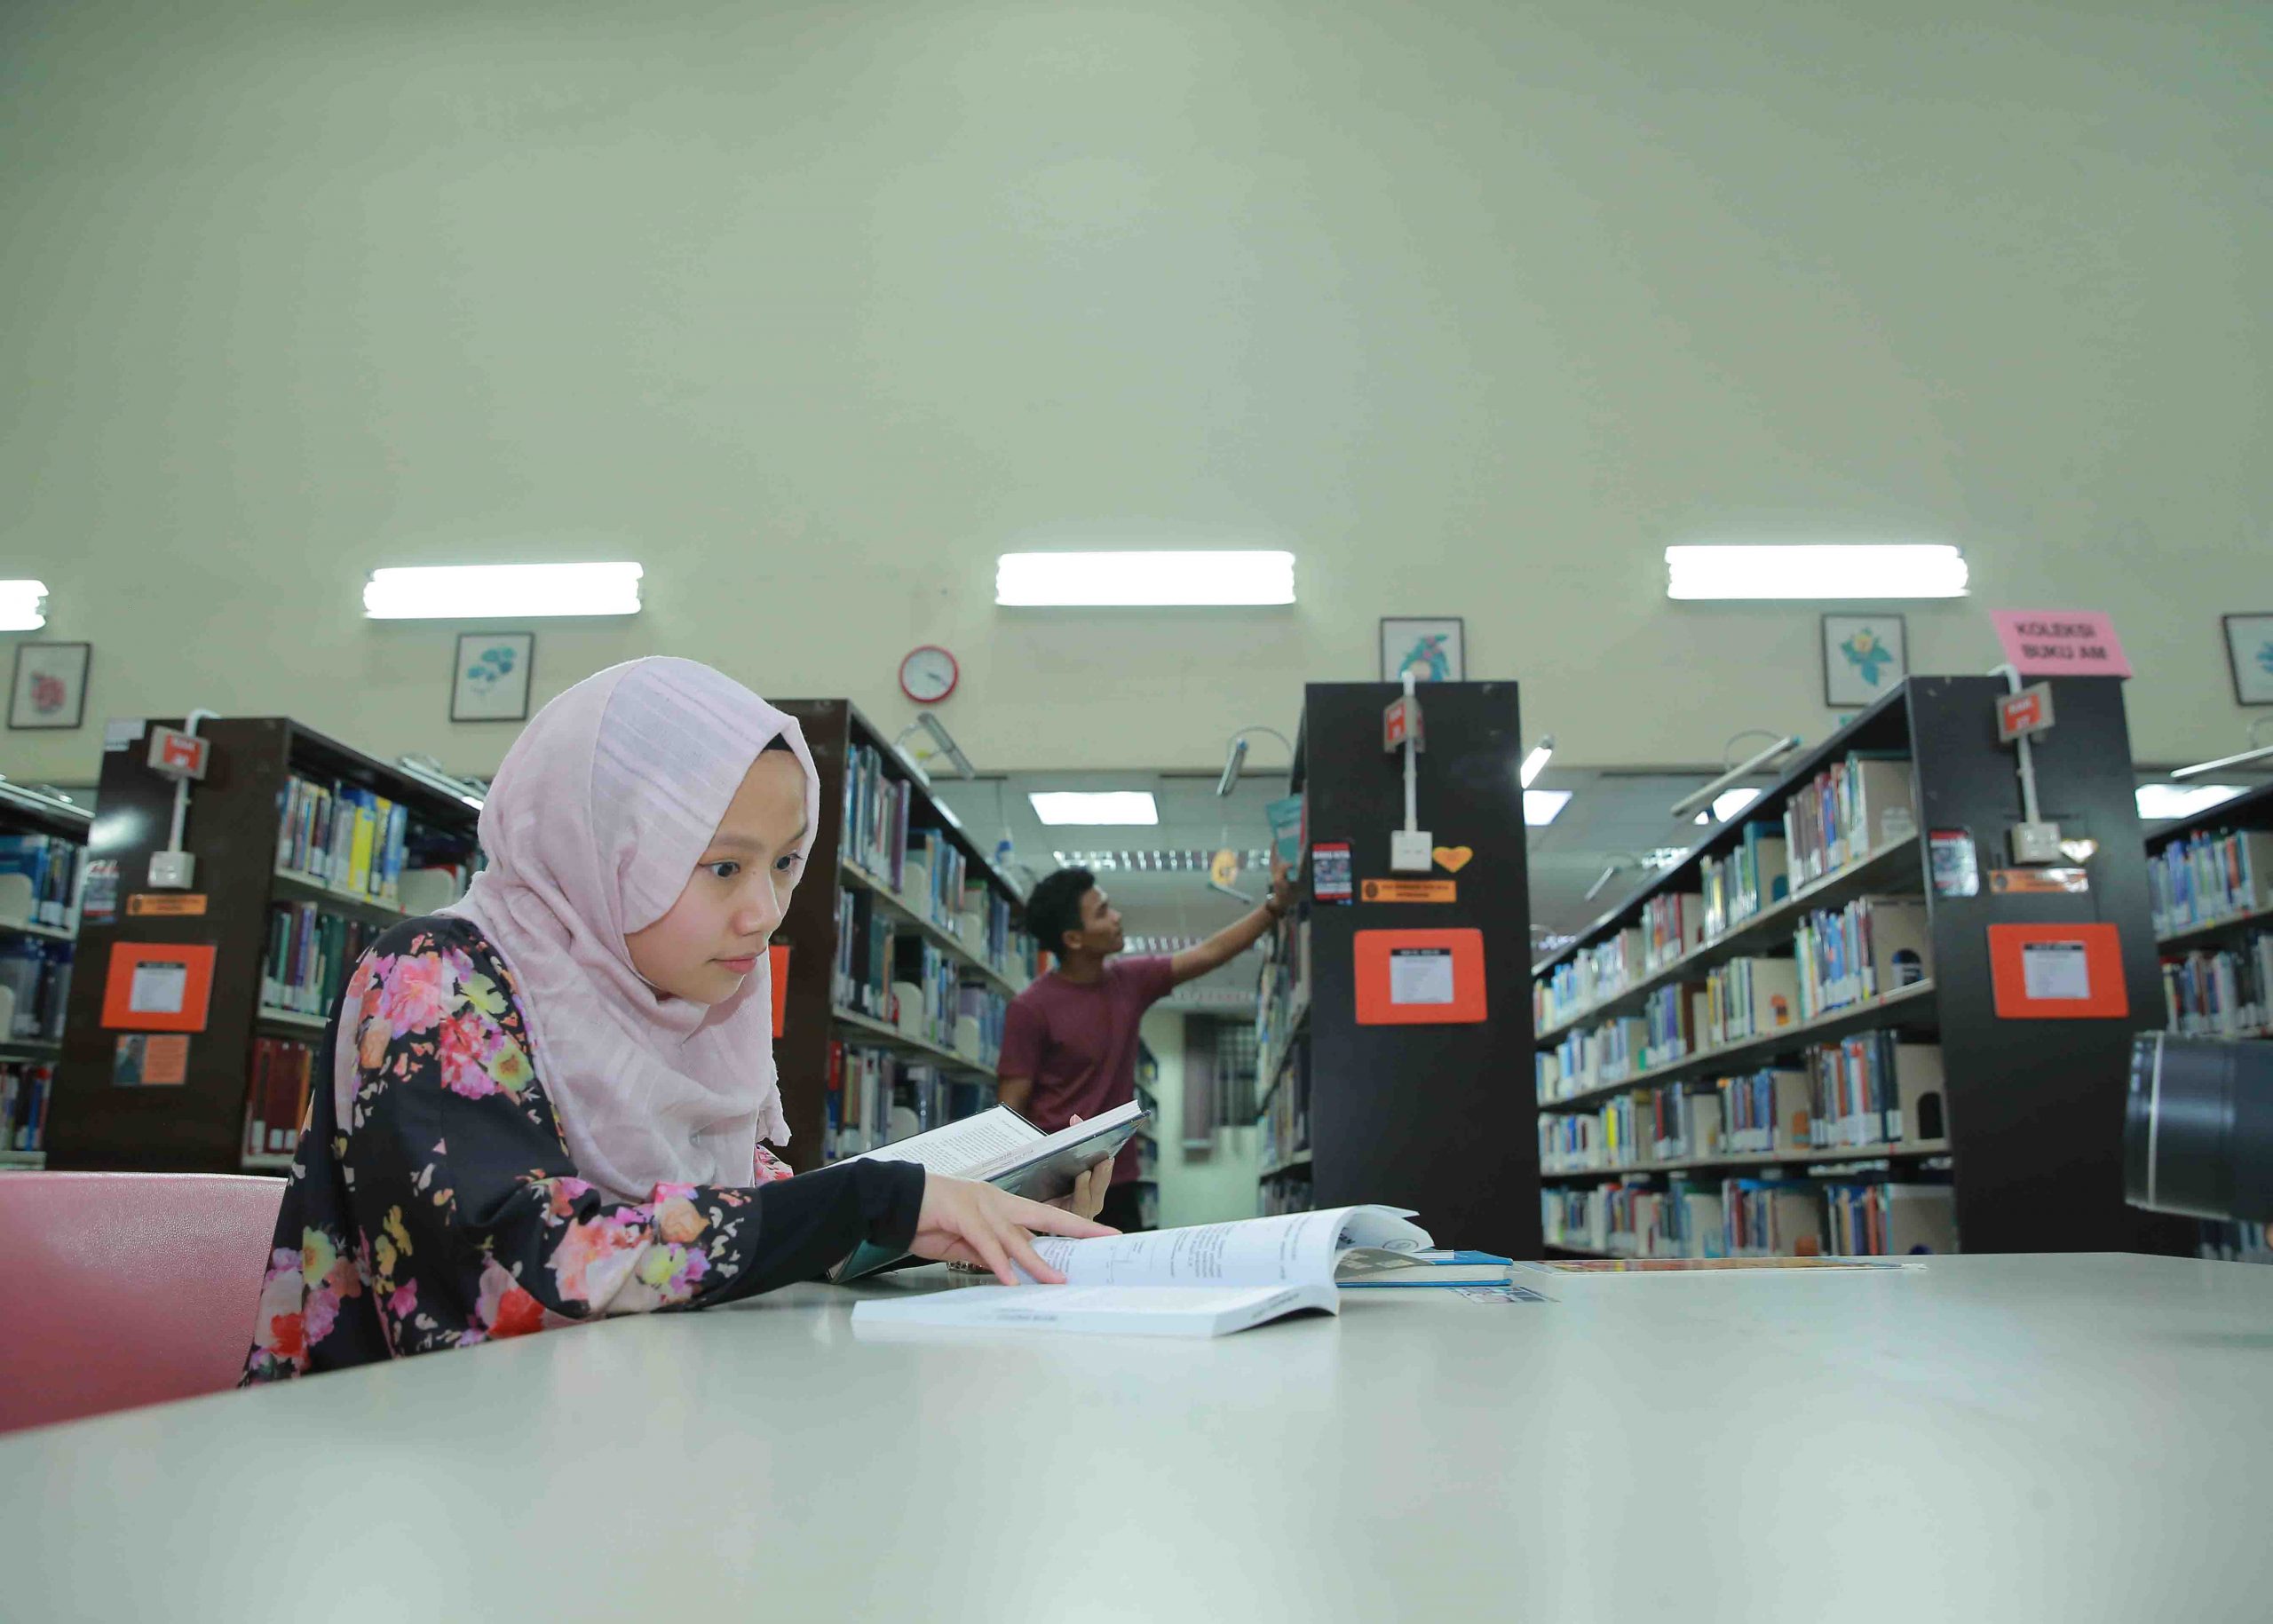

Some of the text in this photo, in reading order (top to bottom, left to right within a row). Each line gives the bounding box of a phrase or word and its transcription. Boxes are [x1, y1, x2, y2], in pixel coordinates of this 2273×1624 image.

[2015, 622, 2095, 638] KOLEKSI
[2022, 644, 2107, 659] BUKU AM
